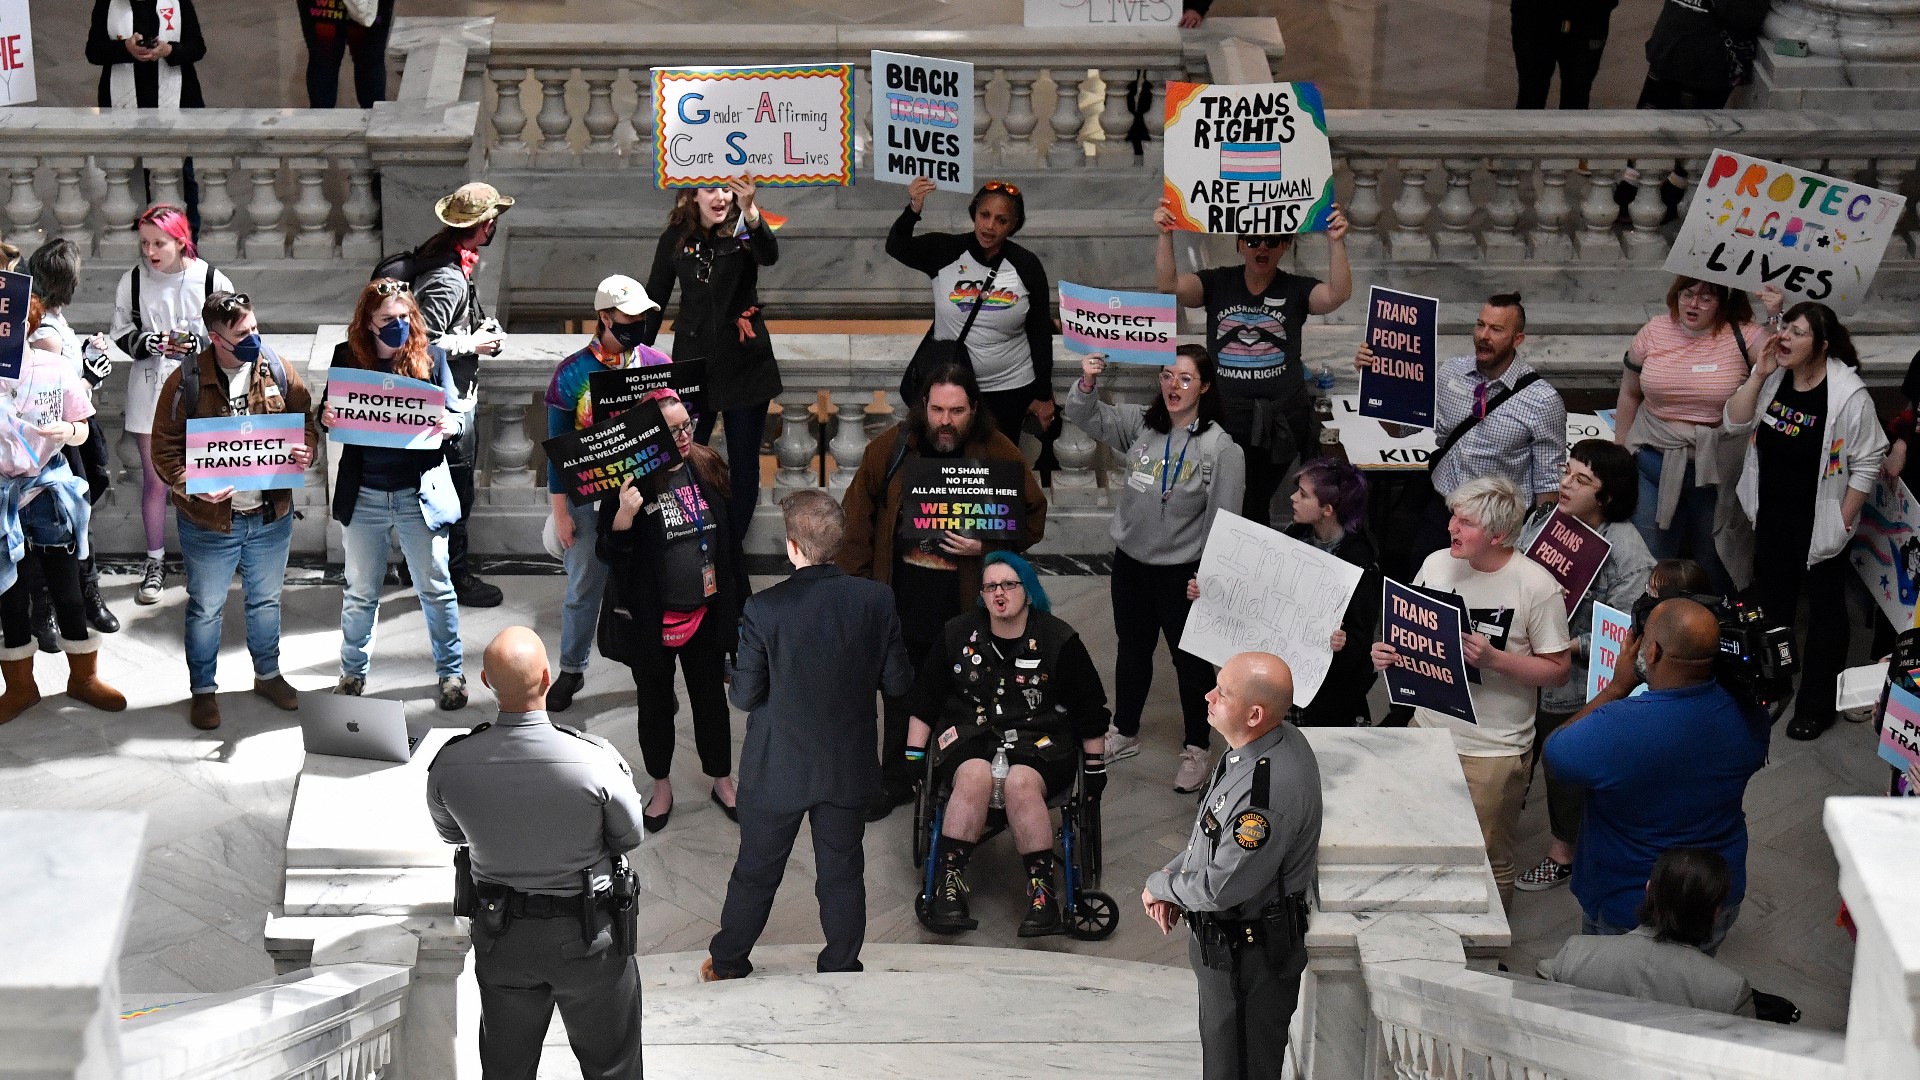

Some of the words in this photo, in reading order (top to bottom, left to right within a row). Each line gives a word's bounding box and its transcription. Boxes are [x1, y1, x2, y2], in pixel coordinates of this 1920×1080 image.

[886, 63, 959, 97] BLACK
[886, 93, 959, 128] TRANS
[1200, 93, 1290, 118] TRANS
[888, 125, 960, 157] LIVES
[1194, 115, 1295, 149] RIGHTS
[669, 133, 714, 166] Care
[726, 132, 773, 165] Saves
[784, 132, 829, 165] Lives
[888, 153, 960, 183] MATTER
[1190, 180, 1240, 203] ARE
[1249, 177, 1312, 203] HUMAN
[1707, 154, 1900, 225] PROTECT
[1208, 204, 1301, 233] RIGHTS
[1706, 242, 1833, 300] LIVES
[1076, 308, 1156, 328] PROTECT
[1269, 309, 1287, 324] ARE
[1376, 299, 1418, 326] TRANS
[1065, 319, 1120, 341] TRANS
[1125, 330, 1168, 344] KIDS
[1372, 327, 1421, 354] PEOPLE
[625, 375, 640, 384] NO
[641, 371, 672, 381] SHAME
[1217, 366, 1252, 379] HUMAN
[1371, 355, 1424, 382] BELONG
[599, 397, 615, 405] ALL
[615, 395, 632, 403] ARE
[678, 385, 700, 395] HERE
[646, 381, 668, 389] FEAR
[348, 392, 427, 410] PROTECT
[334, 407, 392, 423] TRANS
[396, 412, 437, 427] KIDS
[1771, 420, 1800, 437] OUD
[1793, 411, 1817, 428] OUT
[207, 438, 286, 453] PROTECT
[580, 435, 595, 444] NO
[595, 422, 627, 440] SHAME
[588, 442, 603, 452] NO
[604, 433, 626, 448] FEAR
[563, 459, 579, 469] ALL
[579, 454, 595, 464] ARE
[595, 438, 639, 460] WELCOME
[638, 425, 661, 441] HERE
[193, 455, 252, 469] TRANS
[257, 453, 297, 467] KIDS
[576, 476, 622, 496] WITH
[622, 451, 671, 482] PRIDE
[577, 467, 606, 482] WE
[605, 444, 660, 476] STAND
[941, 467, 956, 475] NO
[957, 467, 990, 475] SHAME
[928, 487, 947, 495] ARE
[948, 487, 994, 496] WELCOME
[995, 488, 1018, 497] HERE
[945, 477, 961, 485] NO
[962, 477, 985, 485] FEAR
[920, 502, 949, 515] WE
[952, 502, 1010, 516] STAND
[913, 517, 960, 530] WITH
[964, 518, 1017, 531] PRIDE
[1550, 520, 1584, 553] TRANS
[1535, 541, 1574, 577] PEOPLE
[1391, 593, 1438, 631] TRANS
[1390, 623, 1446, 660] PEOPLE
[1394, 653, 1454, 685] BELONG
[1238, 813, 1269, 828] KENTUCKY
[1235, 834, 1259, 848] POLICE
